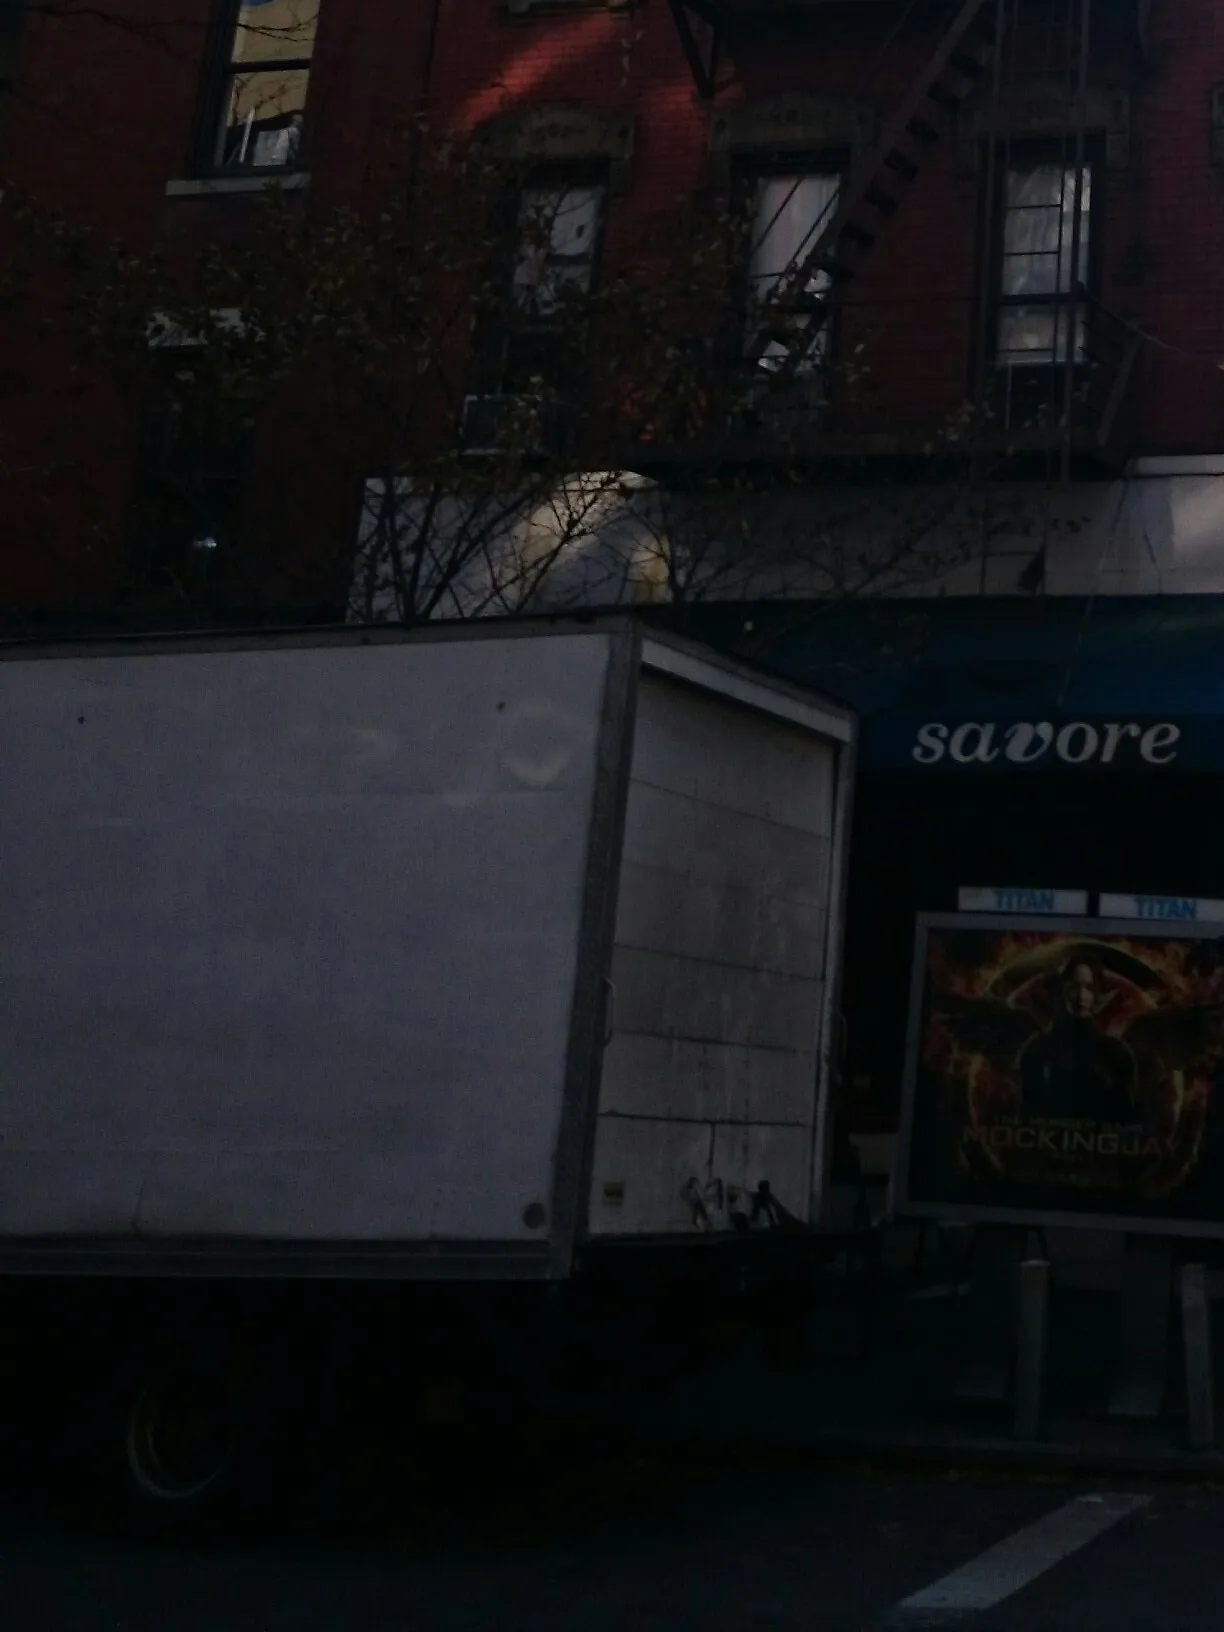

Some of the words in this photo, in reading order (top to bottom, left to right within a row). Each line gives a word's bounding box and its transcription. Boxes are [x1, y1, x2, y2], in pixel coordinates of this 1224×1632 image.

[911, 721, 1182, 764] savore
[993, 889, 1055, 912] TITAN
[1133, 897, 1198, 920] TITAN
[962, 1124, 1181, 1161] MOCKINGJAY
